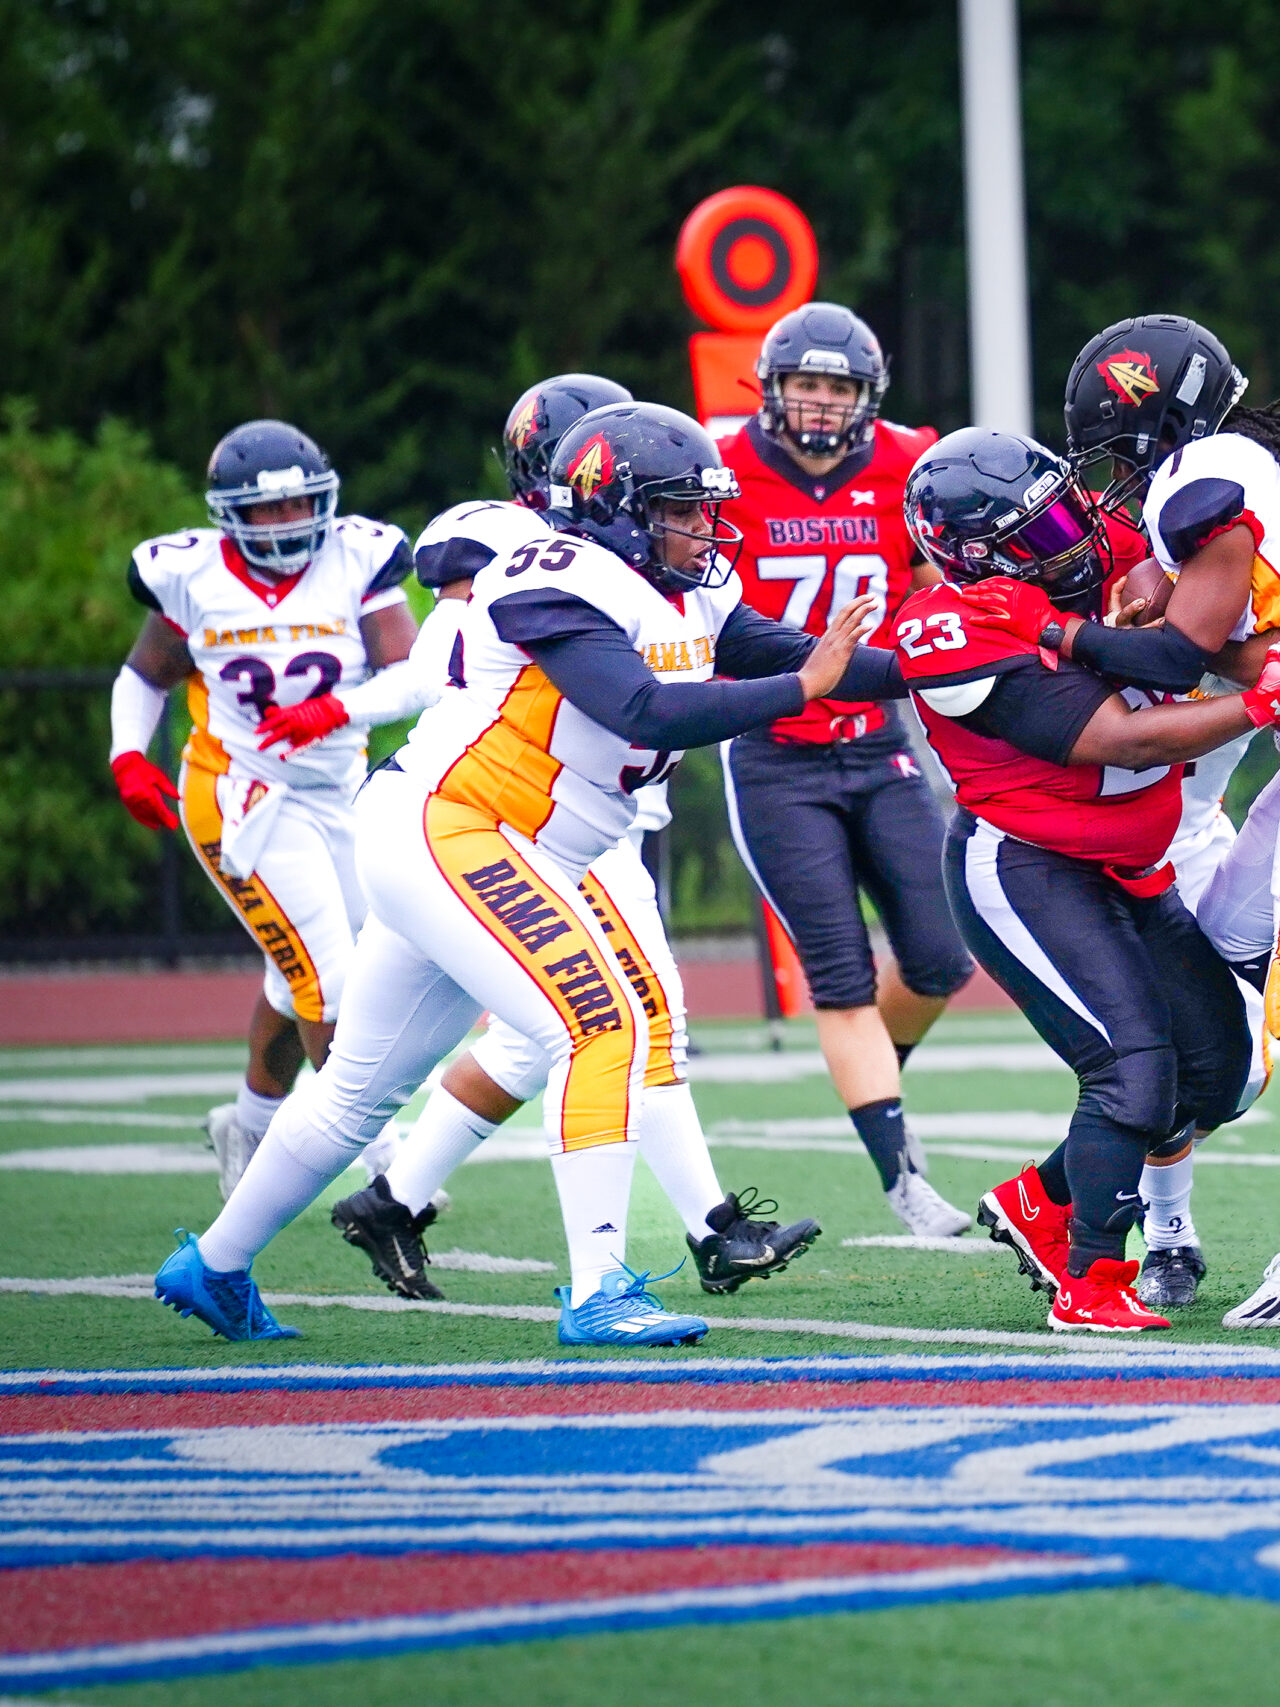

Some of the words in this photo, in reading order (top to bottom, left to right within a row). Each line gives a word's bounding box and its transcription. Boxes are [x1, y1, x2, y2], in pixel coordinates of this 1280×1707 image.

[766, 517, 878, 546] BOSTON
[505, 539, 585, 577] 55
[757, 554, 888, 645] 70
[638, 642, 692, 672] AMA
[897, 612, 968, 659] 23
[219, 651, 342, 721] 32
[462, 859, 573, 955] BAMA
[543, 949, 622, 1037] FIRE
